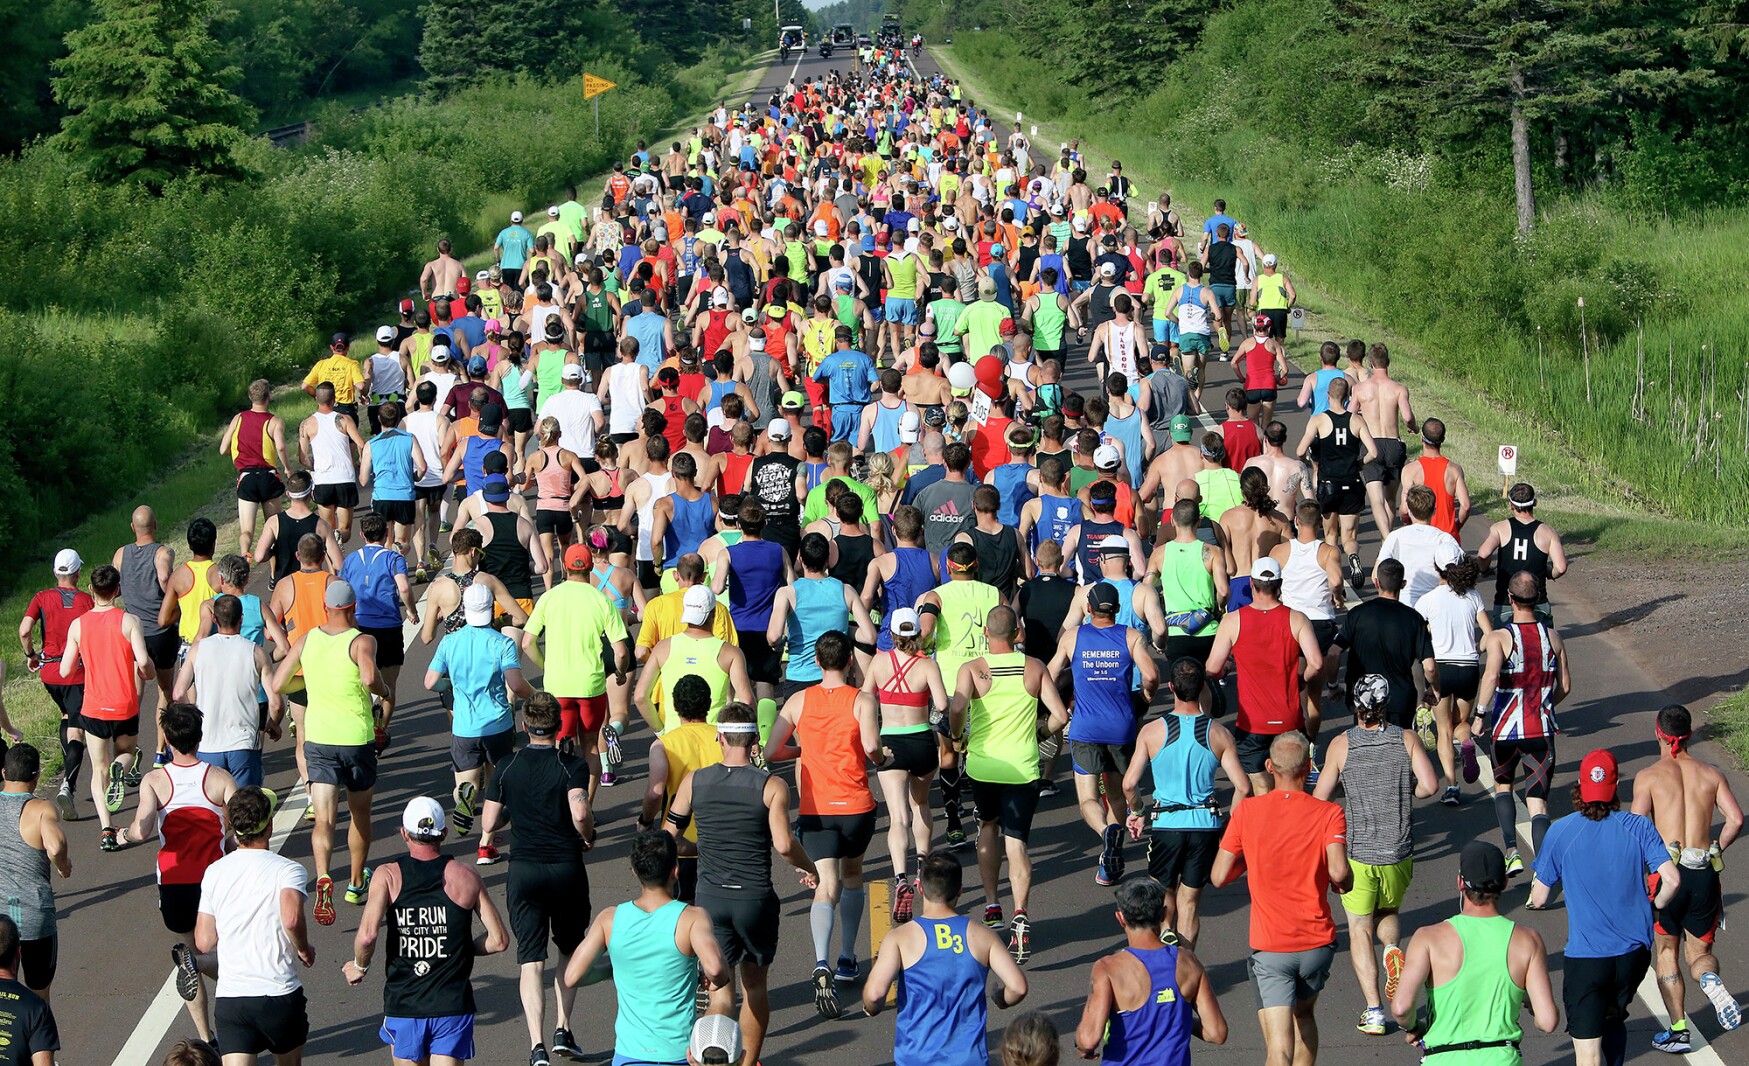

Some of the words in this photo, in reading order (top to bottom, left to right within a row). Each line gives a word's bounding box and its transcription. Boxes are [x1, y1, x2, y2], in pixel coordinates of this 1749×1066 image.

[973, 400, 988, 421] 3:05
[1335, 427, 1347, 446] H
[754, 468, 793, 486] VEGAN
[757, 482, 792, 497] ANIMALS
[929, 513, 964, 523] adidas
[1513, 537, 1528, 561] H
[1081, 650, 1120, 659] REMEMBER
[1082, 660, 1094, 669] The
[1095, 660, 1119, 668] Unborn
[394, 907, 416, 927] WE
[419, 906, 447, 926] RUN
[397, 927, 411, 936] THIS
[413, 926, 429, 936] CITY
[431, 925, 448, 935] WITH
[933, 923, 964, 955] B3
